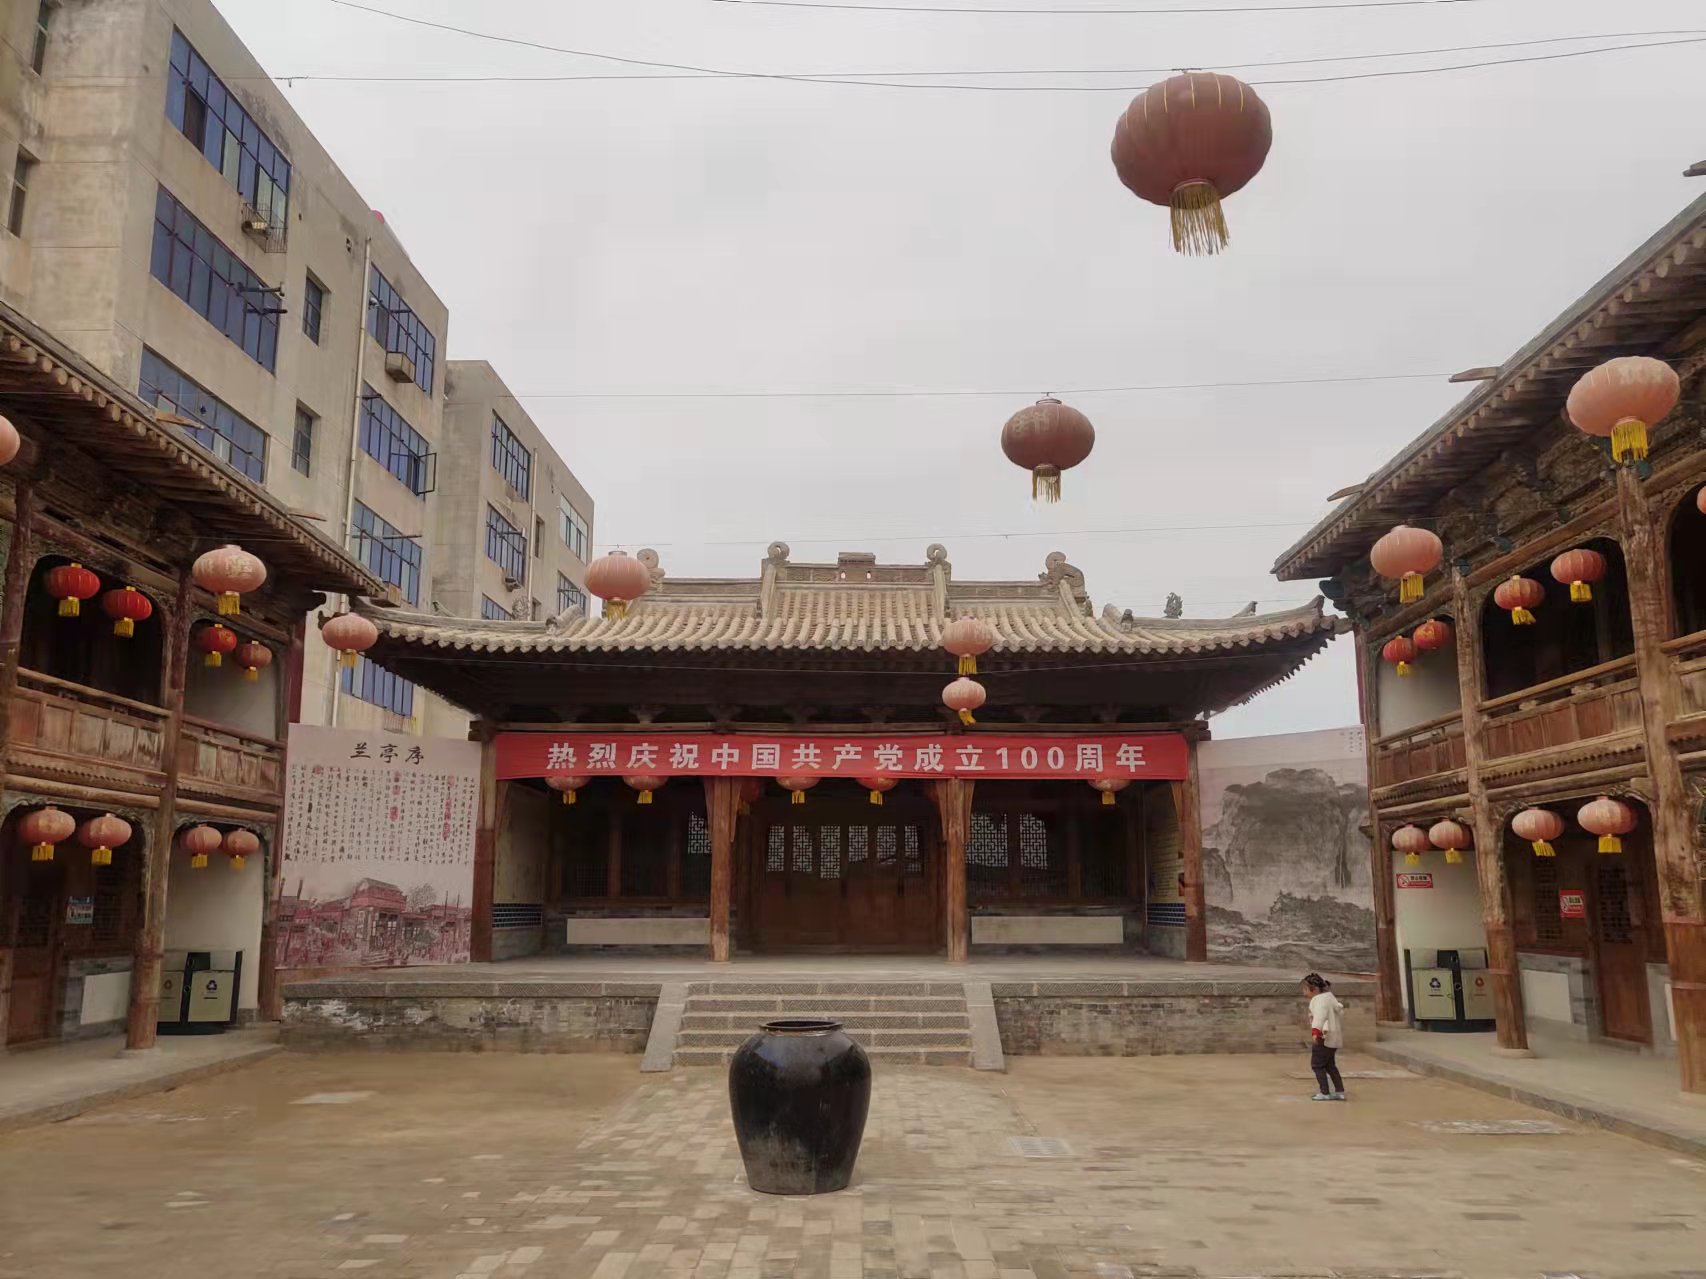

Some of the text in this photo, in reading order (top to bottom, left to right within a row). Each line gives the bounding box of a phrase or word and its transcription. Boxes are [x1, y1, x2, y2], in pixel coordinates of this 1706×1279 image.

[349, 742, 425, 765] 兰亭序
[546, 742, 1146, 773] 热烈庆祝中国共产党成立100周年
